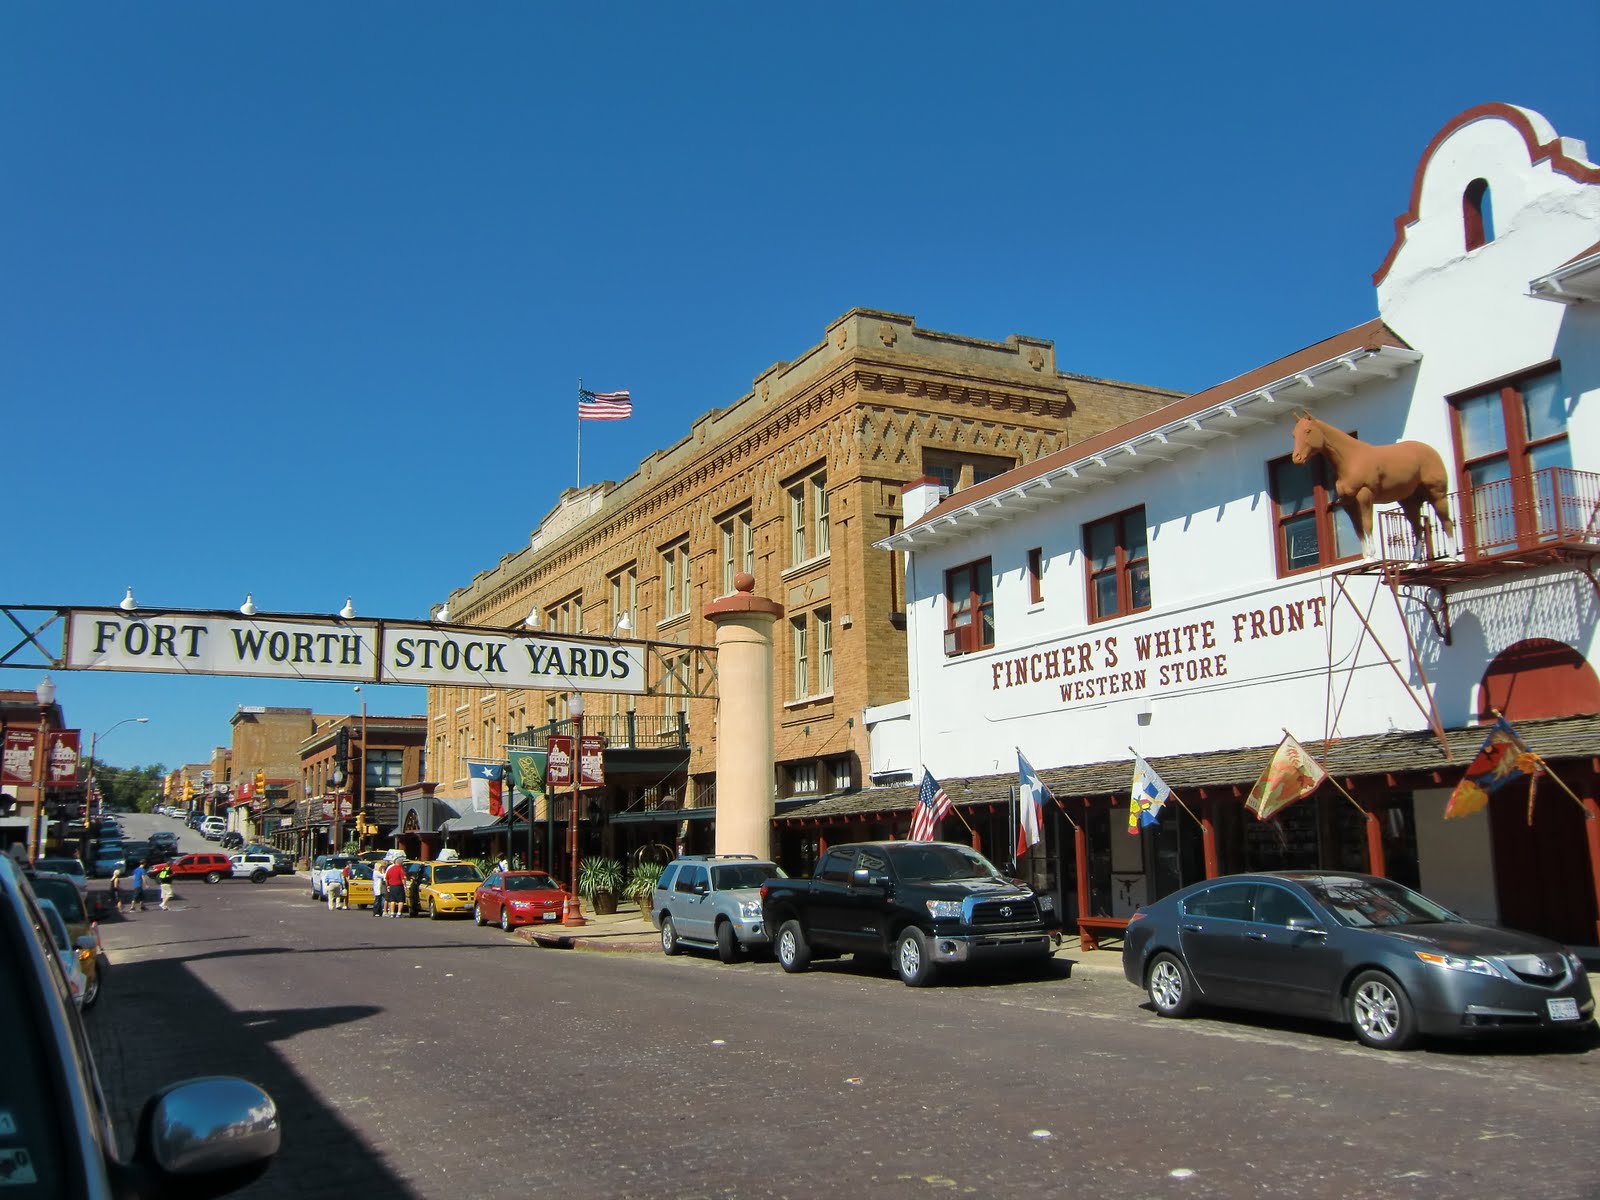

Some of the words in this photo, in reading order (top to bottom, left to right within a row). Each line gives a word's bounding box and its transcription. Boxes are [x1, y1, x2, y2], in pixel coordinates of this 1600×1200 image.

[93, 622, 208, 656] FORT
[232, 628, 362, 665] WORTH
[395, 638, 508, 673] STOCK
[526, 644, 630, 679] YARDS
[992, 637, 1118, 690] FINCHER'S
[1134, 621, 1216, 662] WHITE
[1233, 598, 1326, 643] FRONT
[1060, 669, 1147, 702] WESTERN
[1159, 654, 1227, 686] STORE
